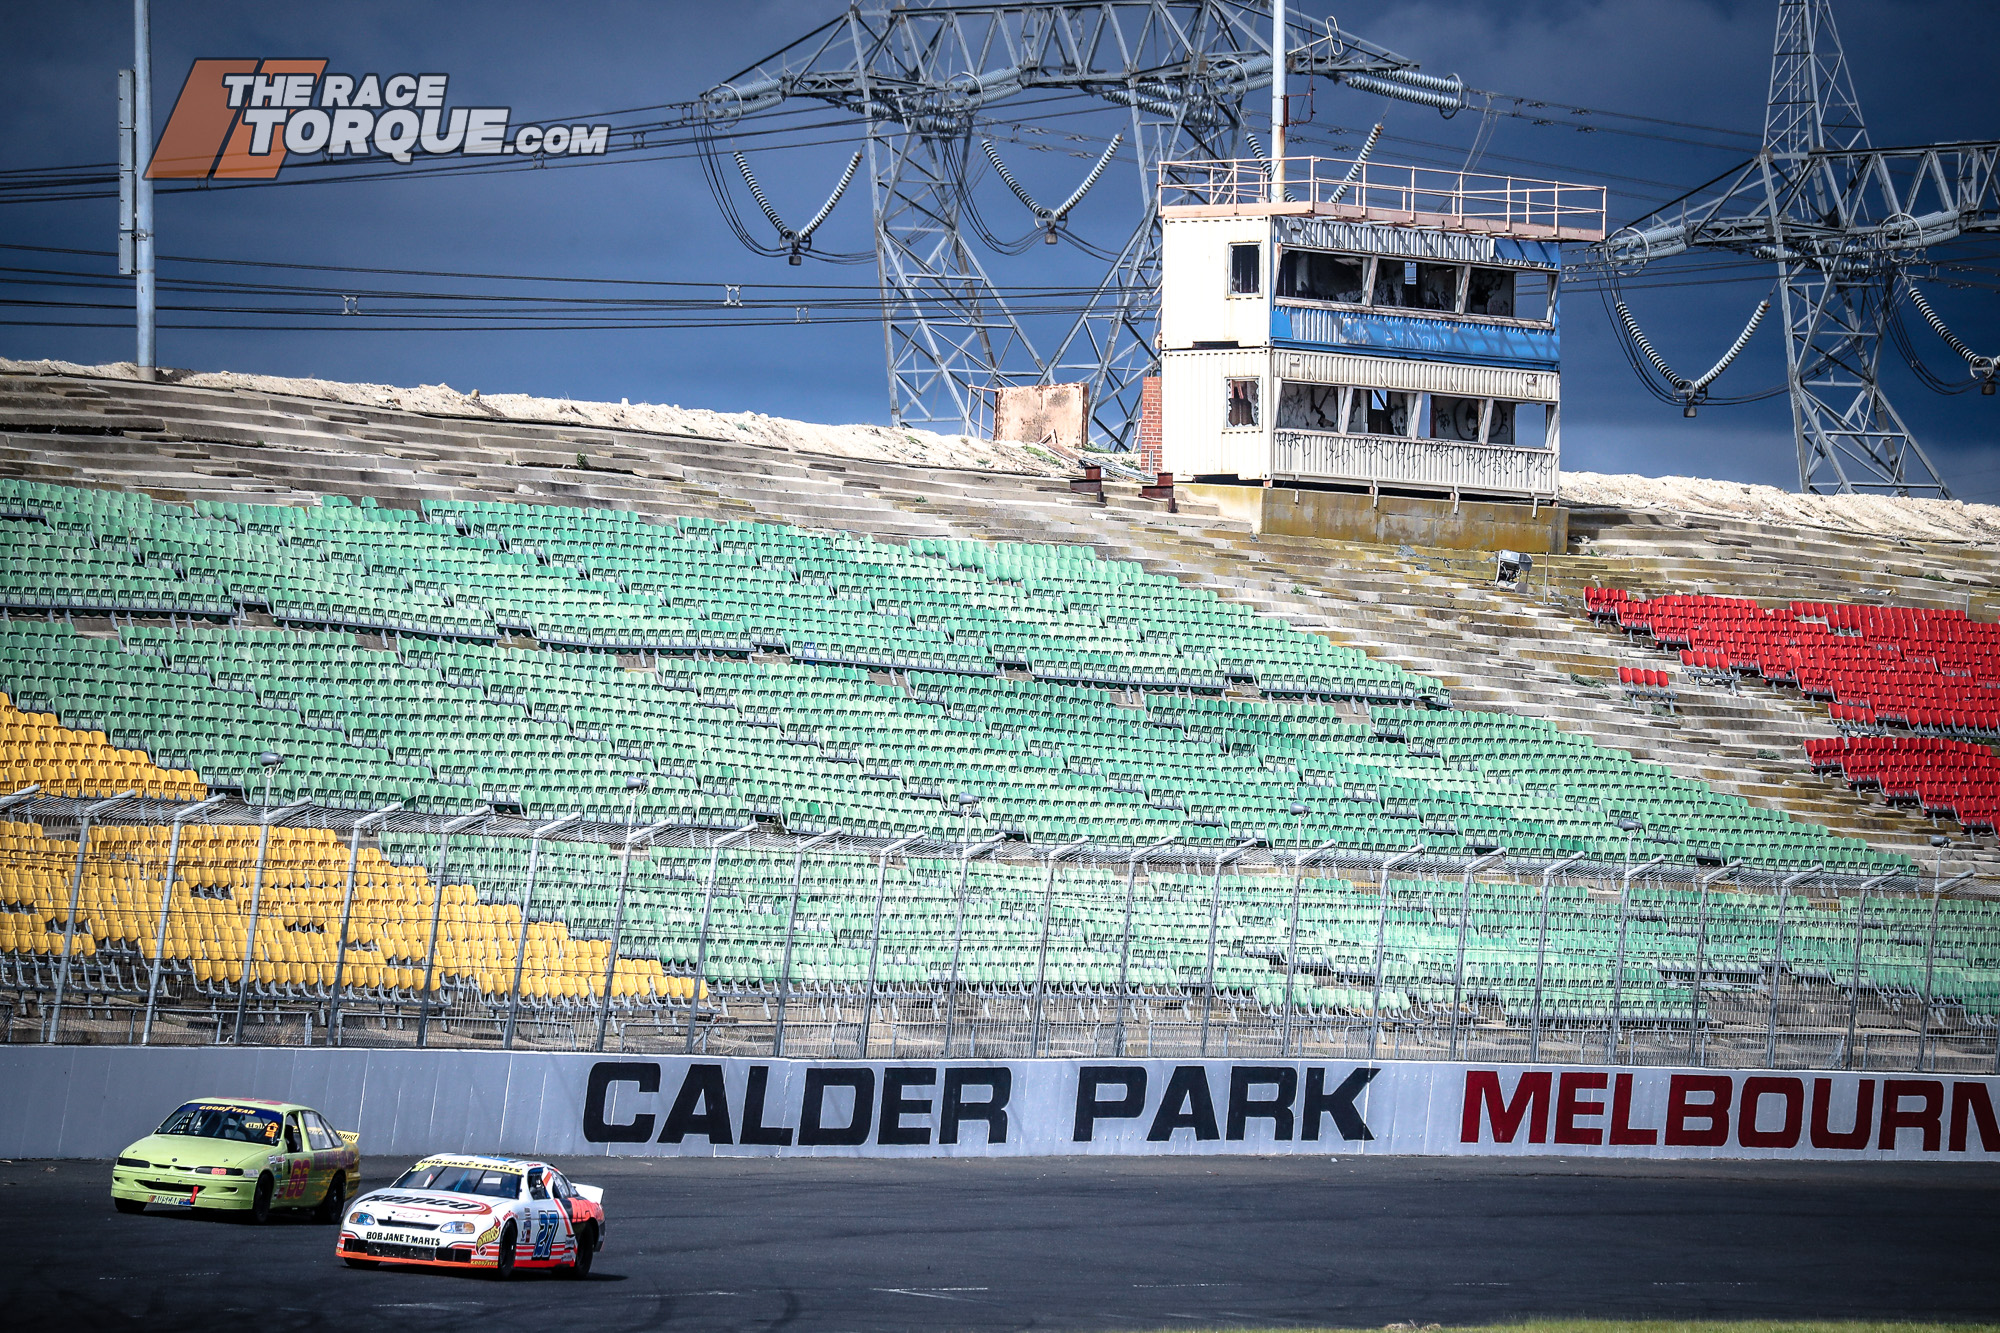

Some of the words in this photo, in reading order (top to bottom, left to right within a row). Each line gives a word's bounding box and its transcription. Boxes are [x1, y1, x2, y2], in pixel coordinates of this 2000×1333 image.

[199, 1105, 256, 1115] GOODYEAR
[583, 1062, 1012, 1146] CALDER
[1073, 1066, 1381, 1143] PARK
[1460, 1070, 2000, 1153] MELBOURN
[284, 1158, 312, 1199] 66
[366, 1231, 383, 1240] BOB
[384, 1232, 404, 1243] JANE
[531, 1210, 559, 1260] 27
